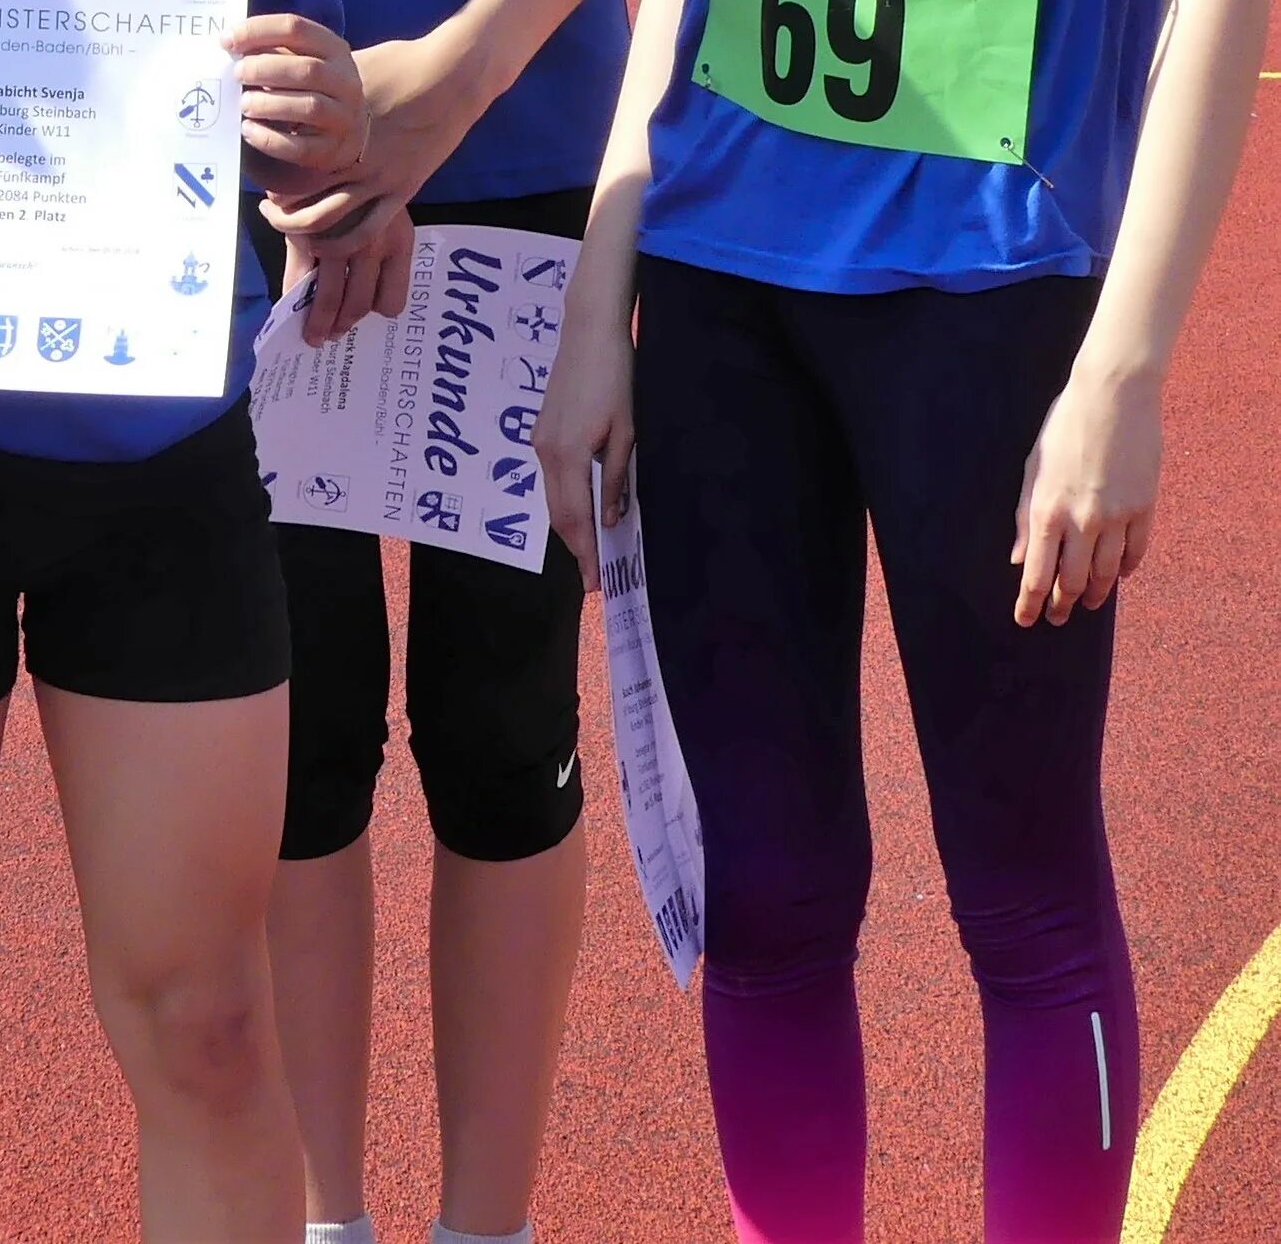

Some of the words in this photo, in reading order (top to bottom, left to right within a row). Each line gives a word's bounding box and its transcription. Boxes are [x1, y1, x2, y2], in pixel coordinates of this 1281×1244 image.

[41, 87, 85, 102] Svenja
[33, 105, 96, 119] Steinbach
[42, 125, 70, 137] W11
[50, 154, 65, 166] im
[33, 191, 86, 204] Punkten
[34, 210, 66, 222] Platz
[424, 248, 502, 477] Urkunde
[337, 355, 354, 410] Magdalena
[383, 242, 436, 522] KREISMEISTERSCHAFTEN
